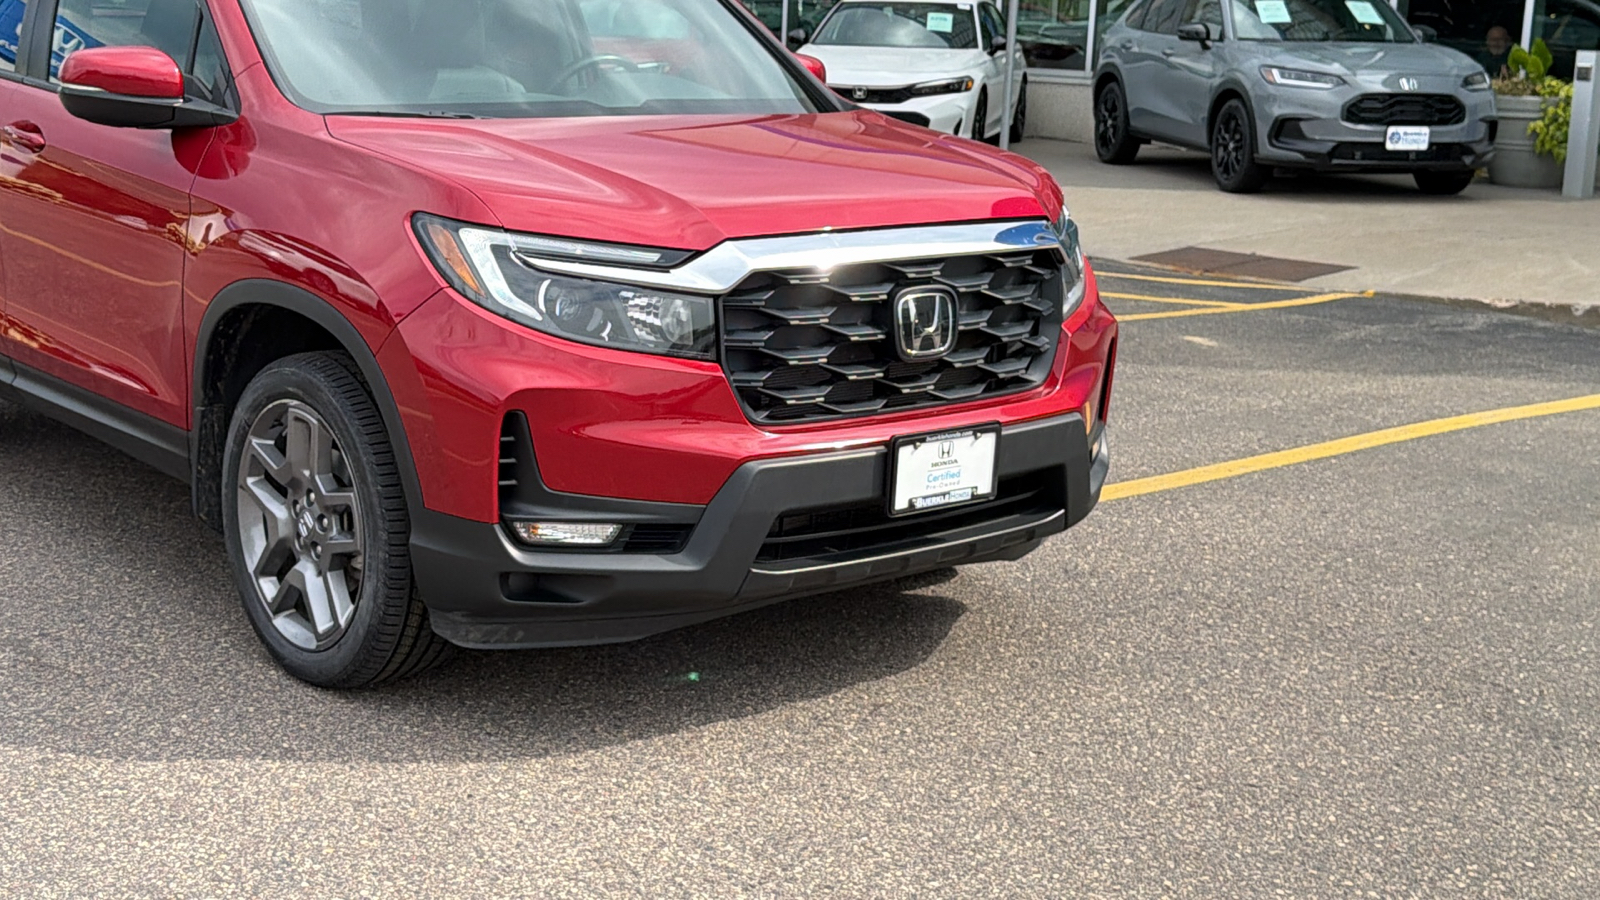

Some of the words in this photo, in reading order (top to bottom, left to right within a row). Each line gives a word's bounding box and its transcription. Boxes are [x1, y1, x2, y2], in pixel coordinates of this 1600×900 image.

[931, 458, 958, 468] HONDA
[927, 470, 960, 482] Certified
[926, 480, 960, 490] Pre-Owned
[916, 494, 950, 508] BUERKLE
